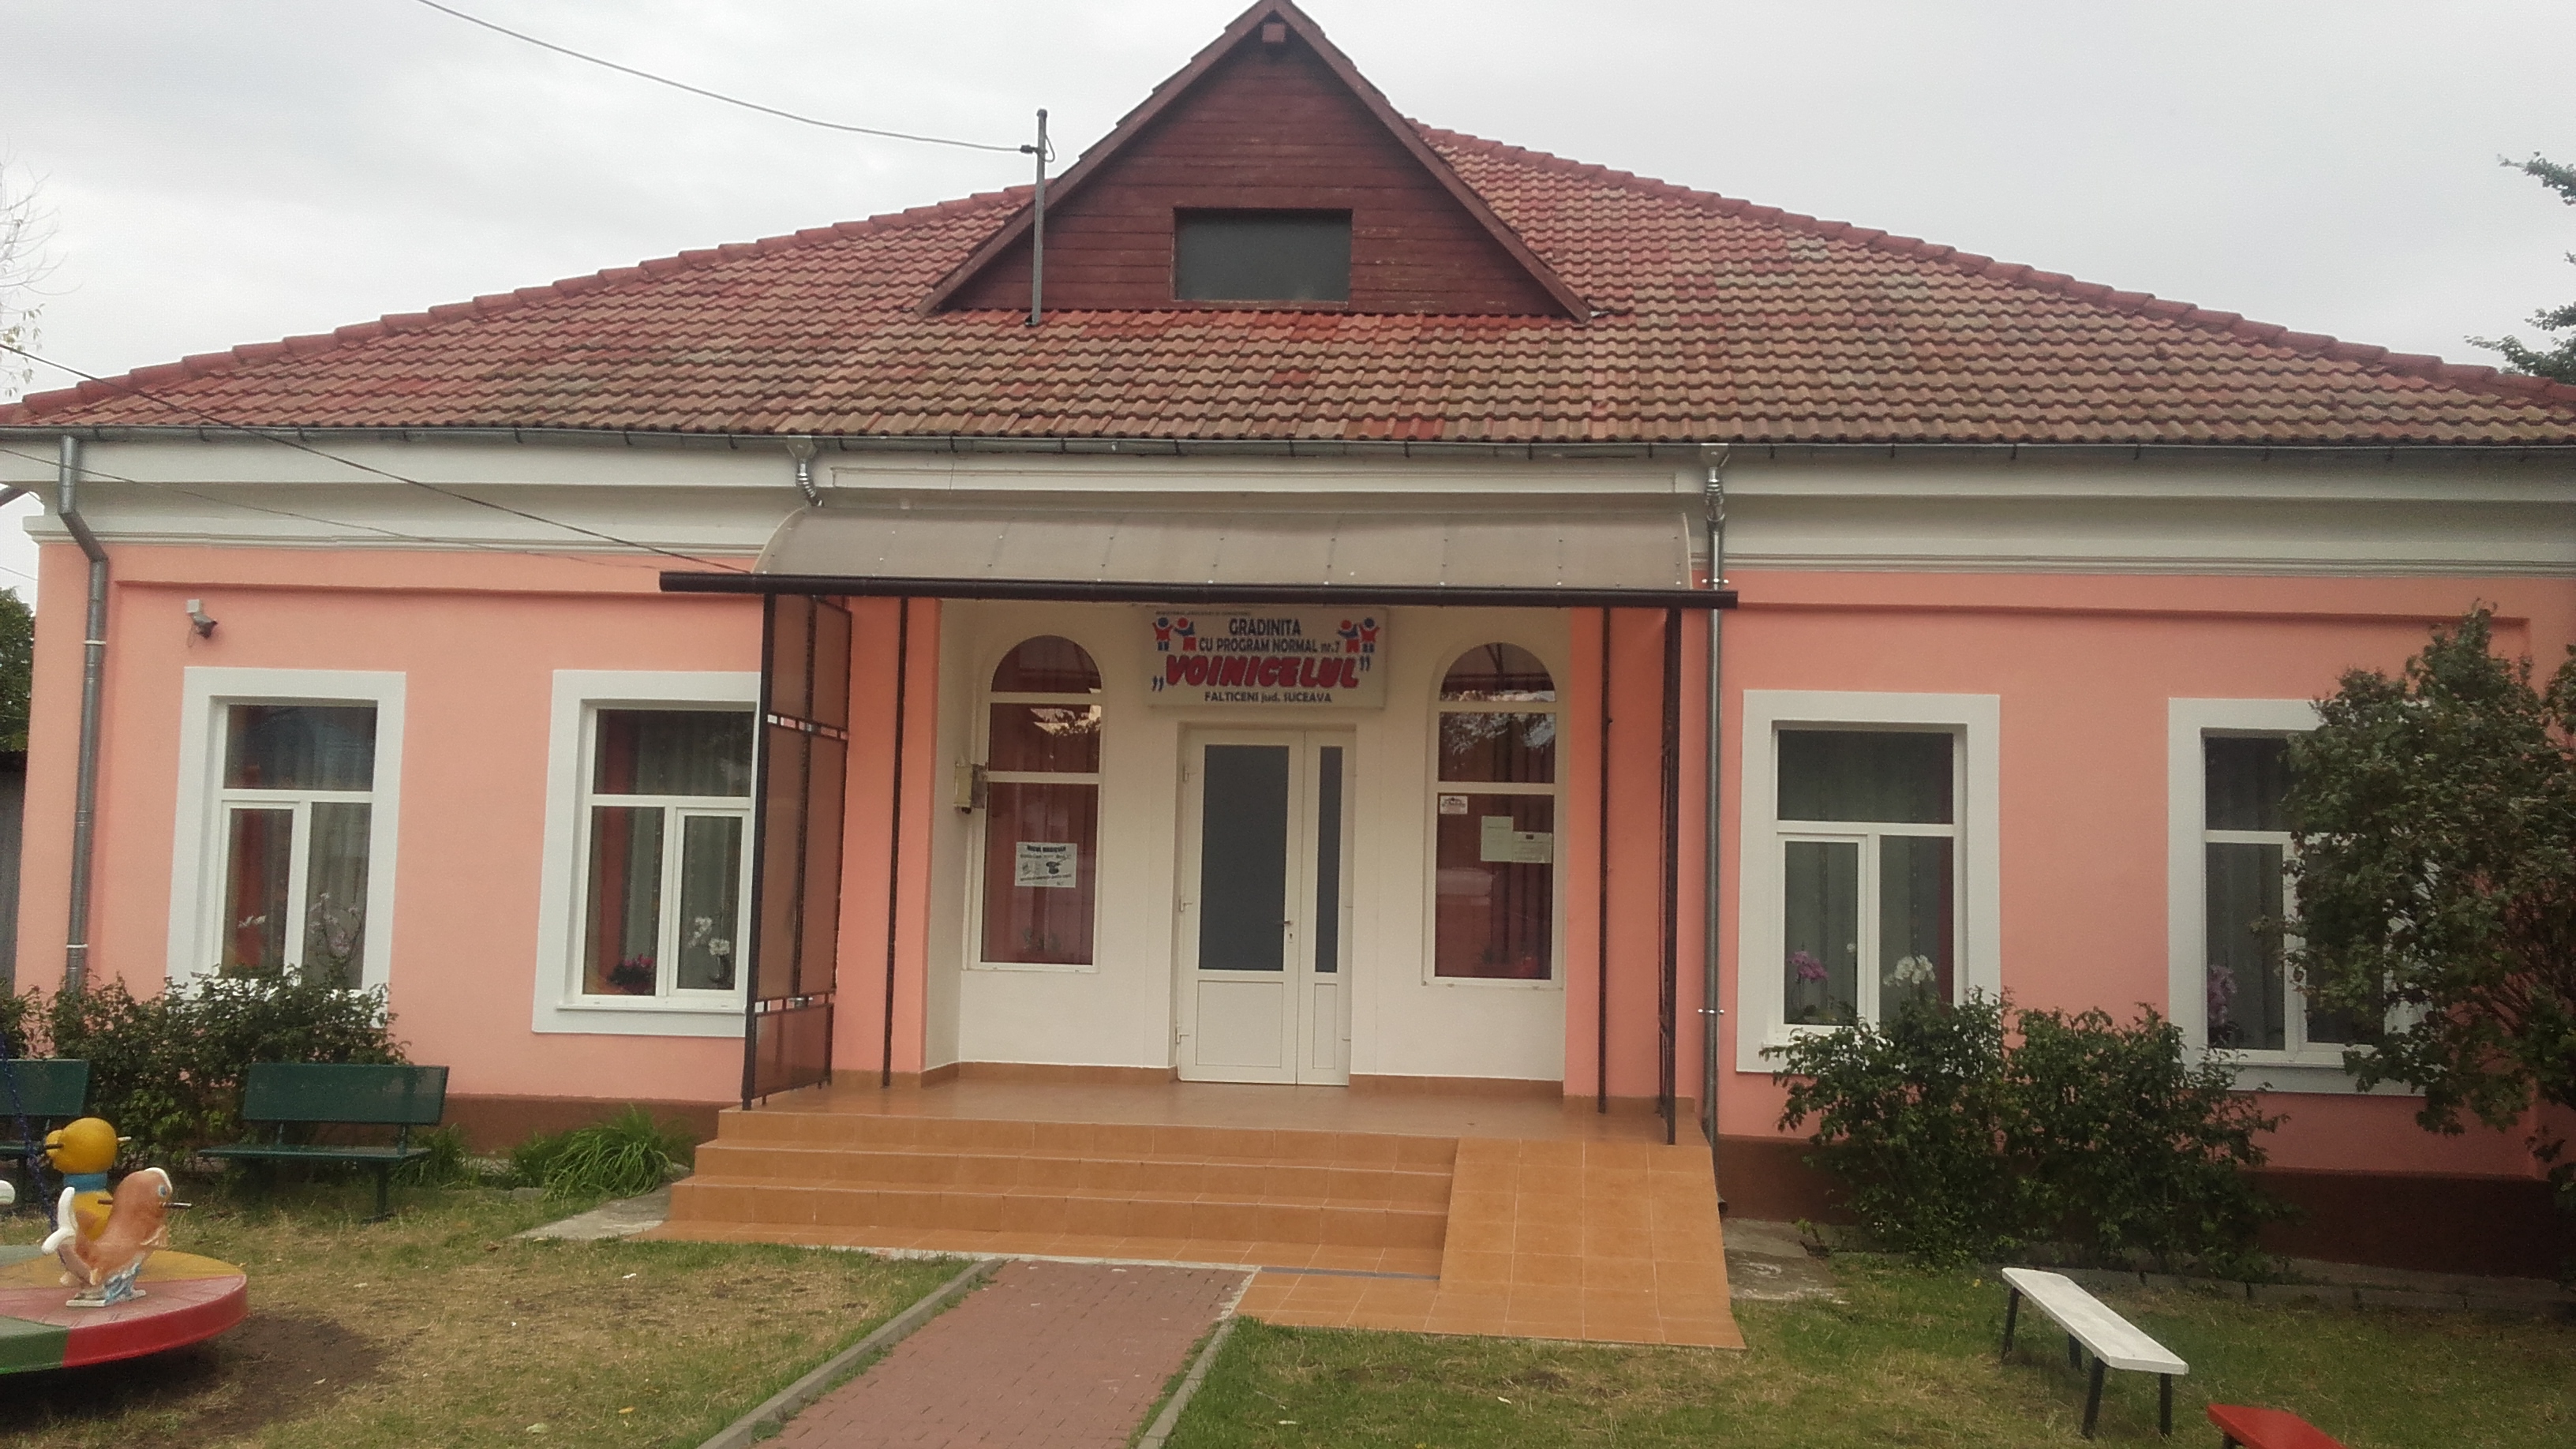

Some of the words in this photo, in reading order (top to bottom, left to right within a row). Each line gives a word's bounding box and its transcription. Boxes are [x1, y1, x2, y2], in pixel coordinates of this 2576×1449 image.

[1229, 618, 1301, 636] GRADINITA
[1200, 638, 1212, 651] CU
[1216, 638, 1269, 653] PROGRAM
[1271, 638, 1317, 653] NORMAL
[1204, 691, 1259, 702] FALTICENI
[1261, 692, 1280, 703] jud.
[1284, 692, 1332, 703] SUCEAVA
